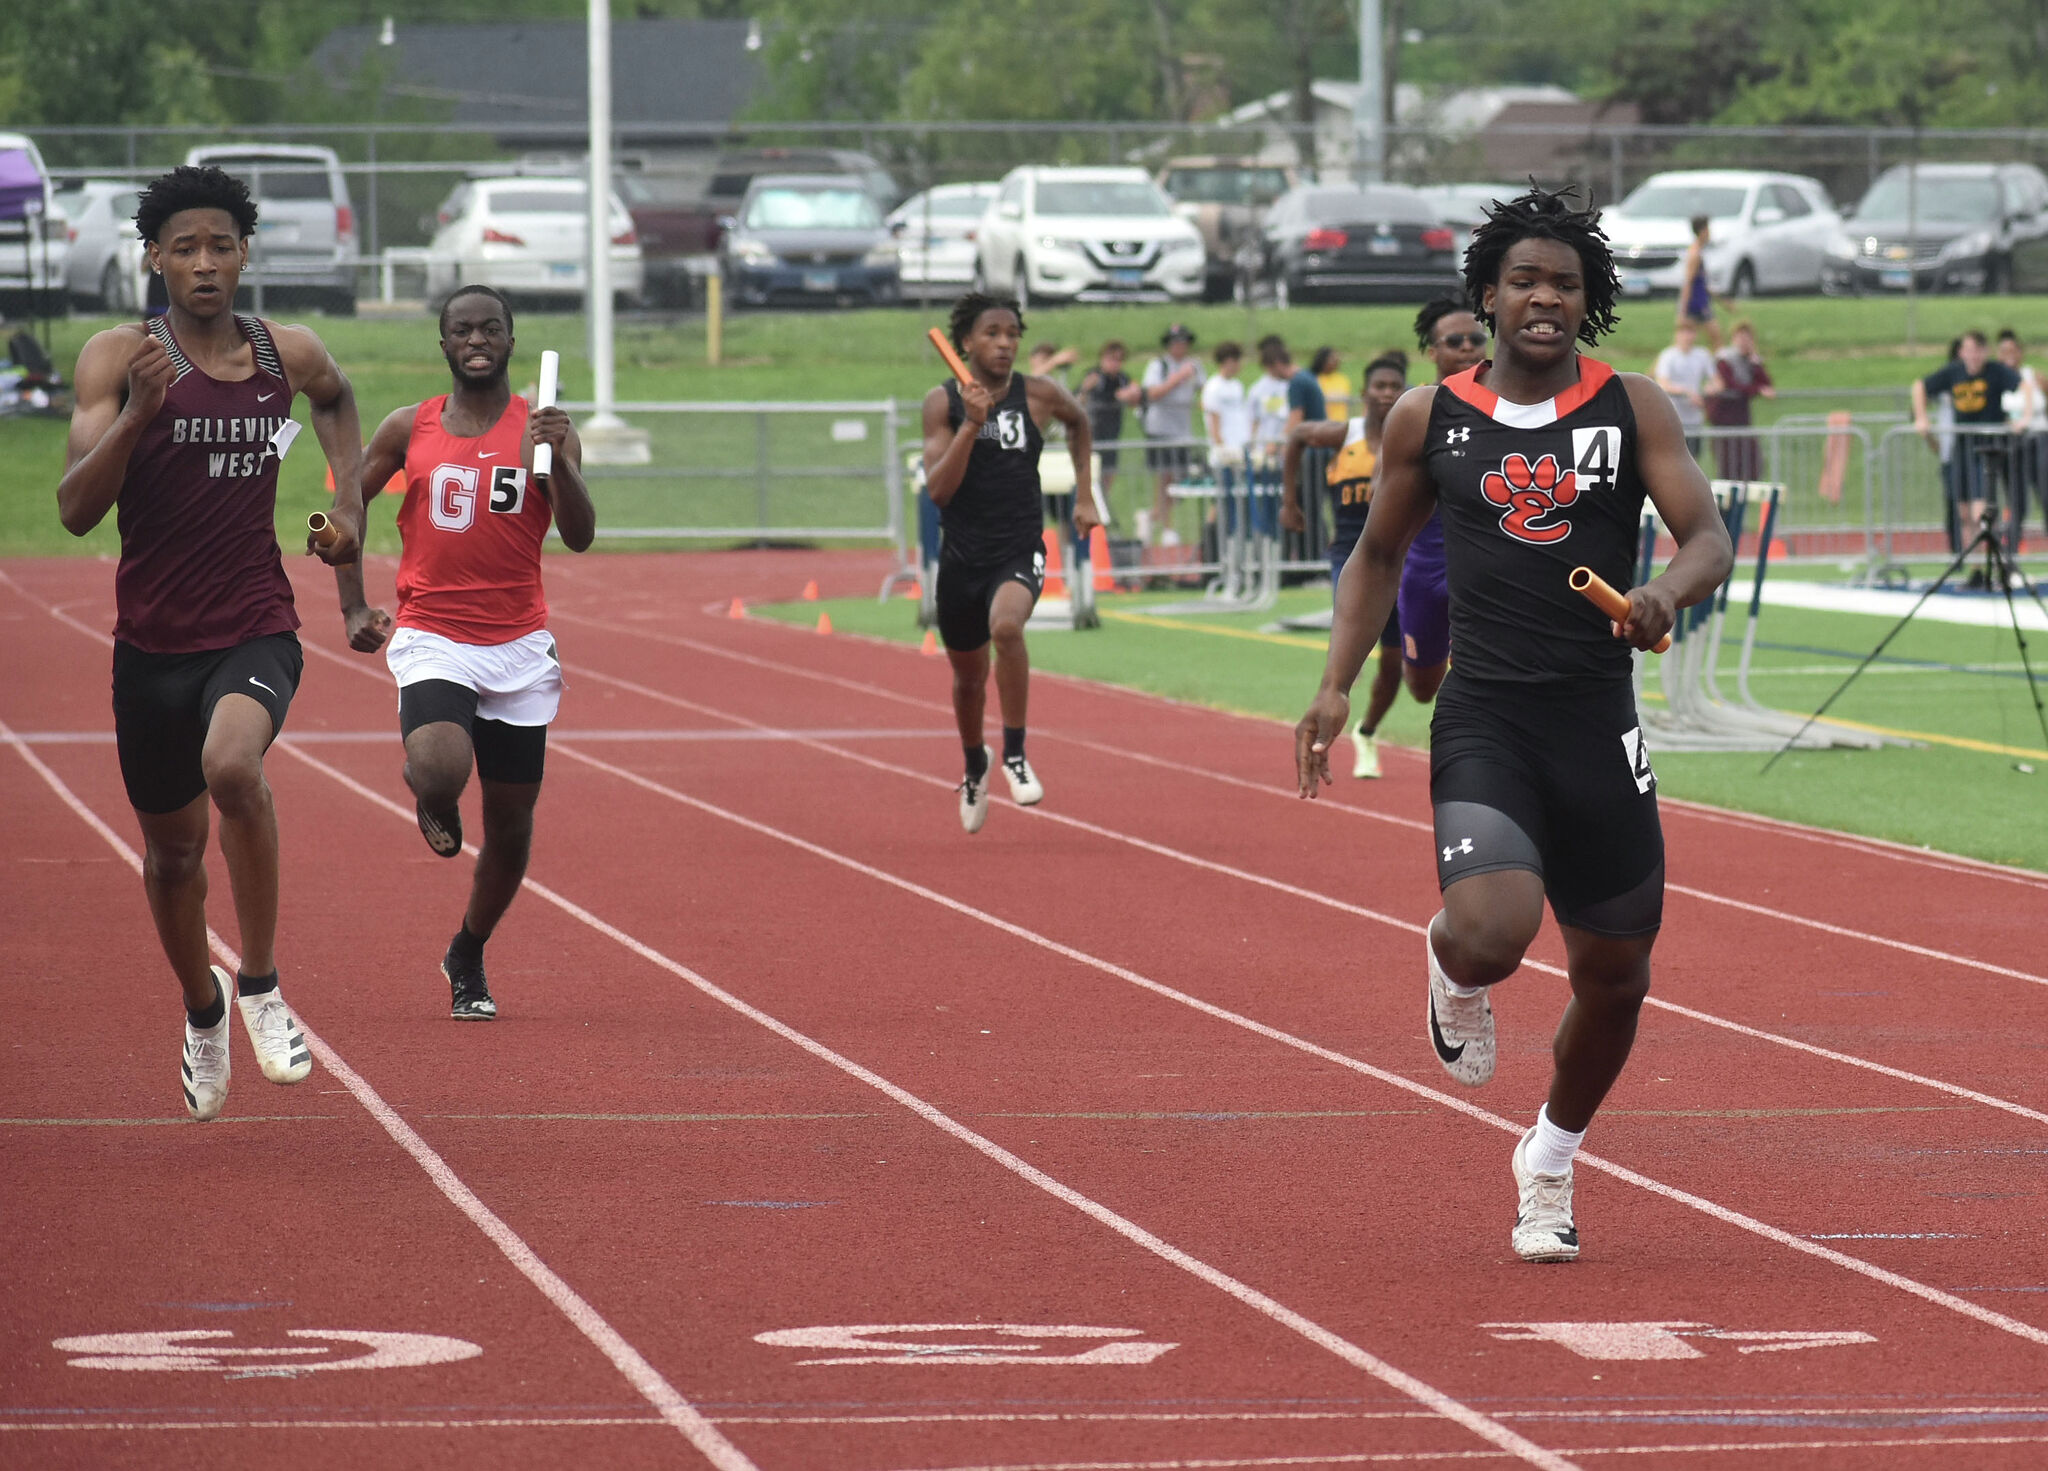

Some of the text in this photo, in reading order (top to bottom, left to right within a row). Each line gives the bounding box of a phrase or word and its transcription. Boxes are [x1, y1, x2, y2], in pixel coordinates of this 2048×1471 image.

[172, 416, 289, 443] BELLEVIL
[1001, 411, 1020, 446] 3
[208, 452, 266, 478] WEST
[1576, 429, 1615, 489] 4
[428, 463, 480, 533] G
[489, 468, 518, 512] 5
[752, 1323, 1180, 1365] 5
[1477, 1321, 1878, 1361] 4
